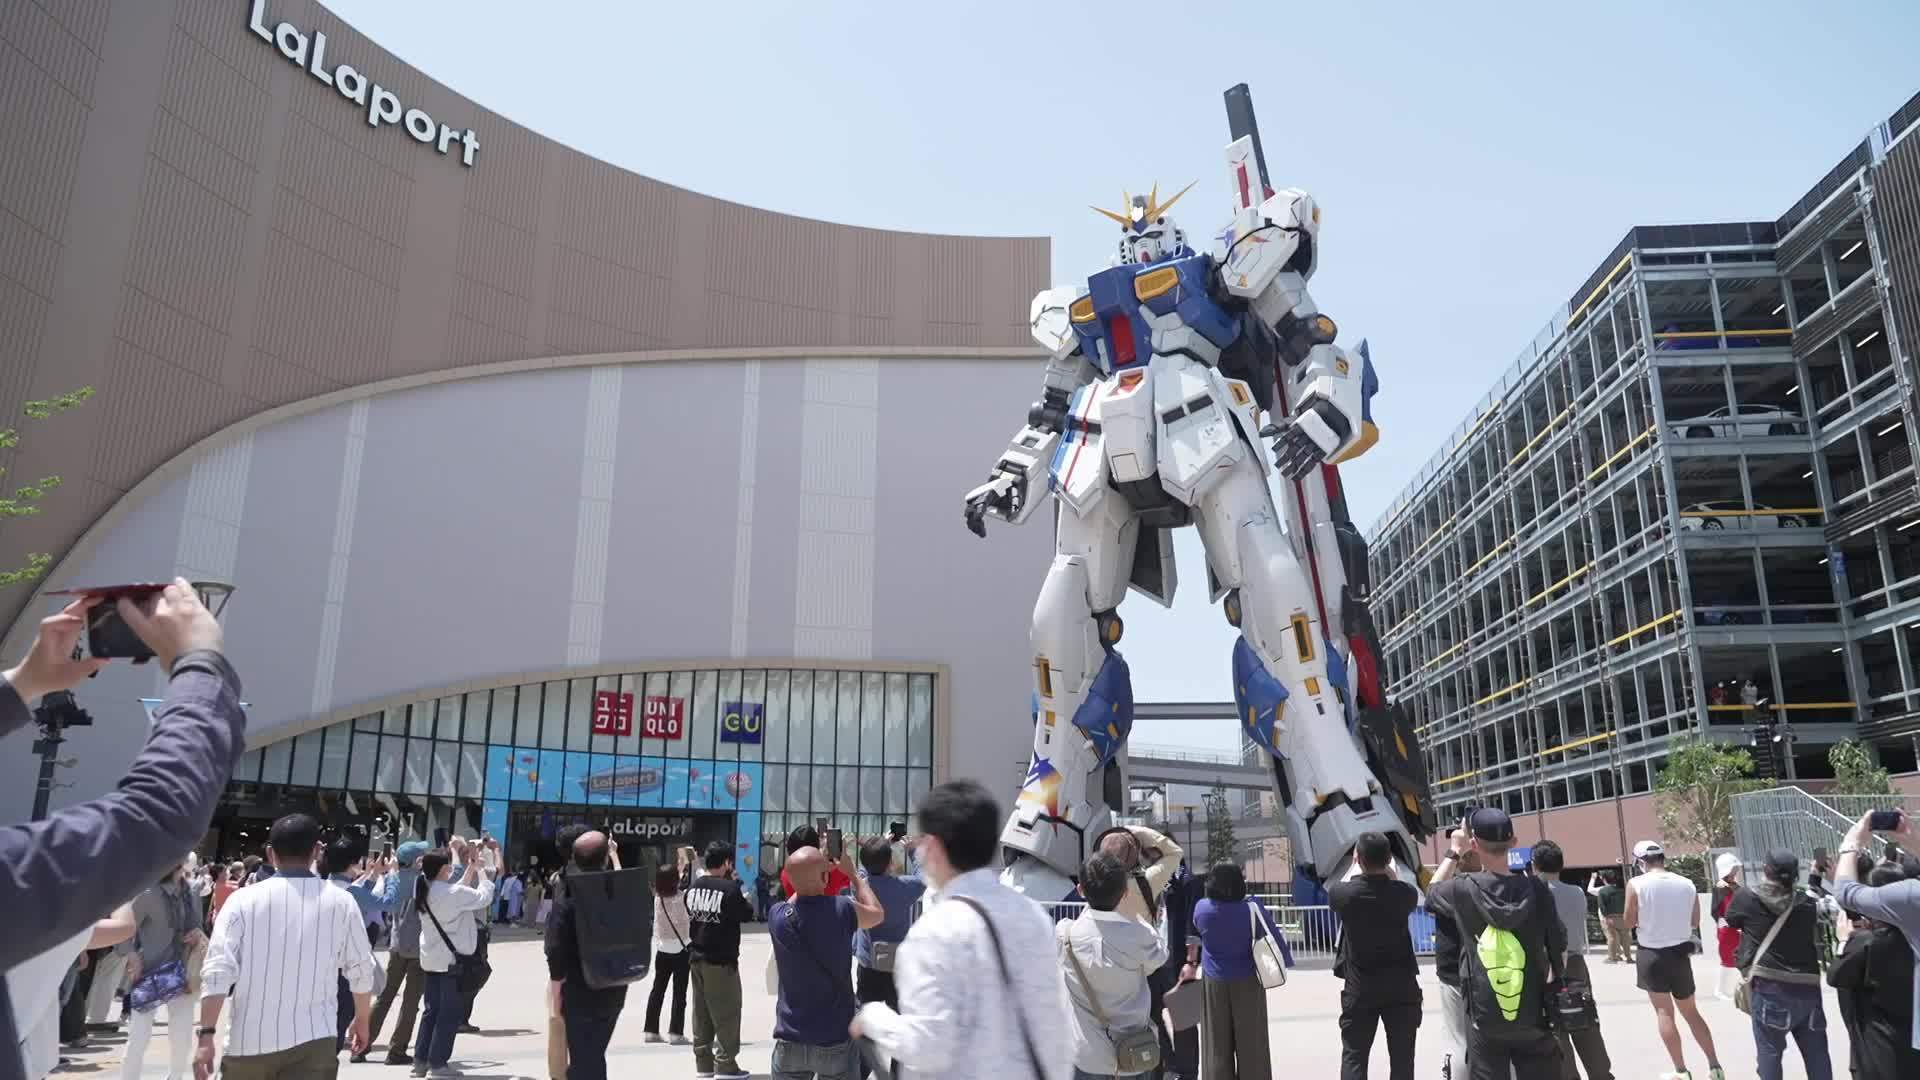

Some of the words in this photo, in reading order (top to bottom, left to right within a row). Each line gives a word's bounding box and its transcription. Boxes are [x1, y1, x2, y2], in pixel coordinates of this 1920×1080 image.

[250, 0, 480, 167] LaLaport
[647, 701, 676, 717] UNI
[646, 718, 678, 735] QLO
[724, 713, 760, 733] GU
